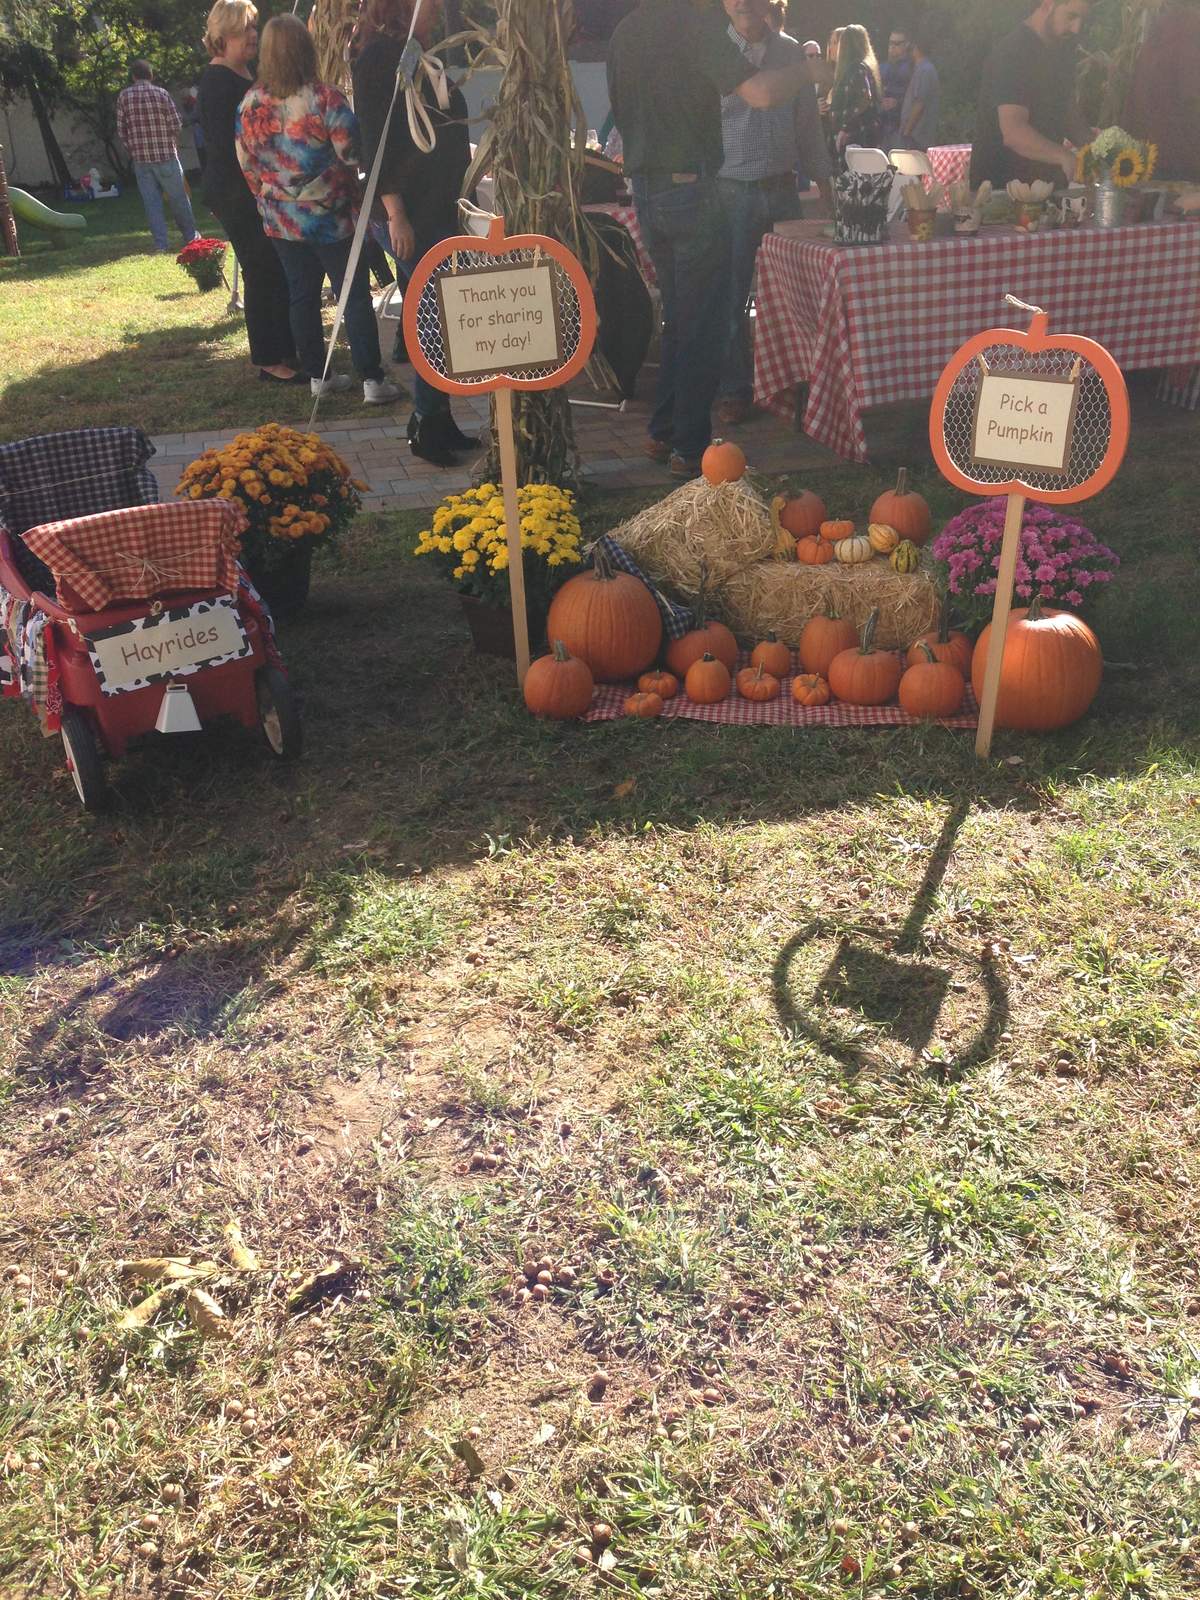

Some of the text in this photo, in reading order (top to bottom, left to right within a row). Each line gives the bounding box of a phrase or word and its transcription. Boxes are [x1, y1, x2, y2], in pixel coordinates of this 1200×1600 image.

[458, 285, 536, 303] Thank you
[458, 307, 543, 330] for sharing
[475, 331, 531, 355] my day!
[1000, 393, 1048, 415] Pick a
[987, 419, 1053, 445] Pumpkin
[120, 626, 219, 666] Hayrides
